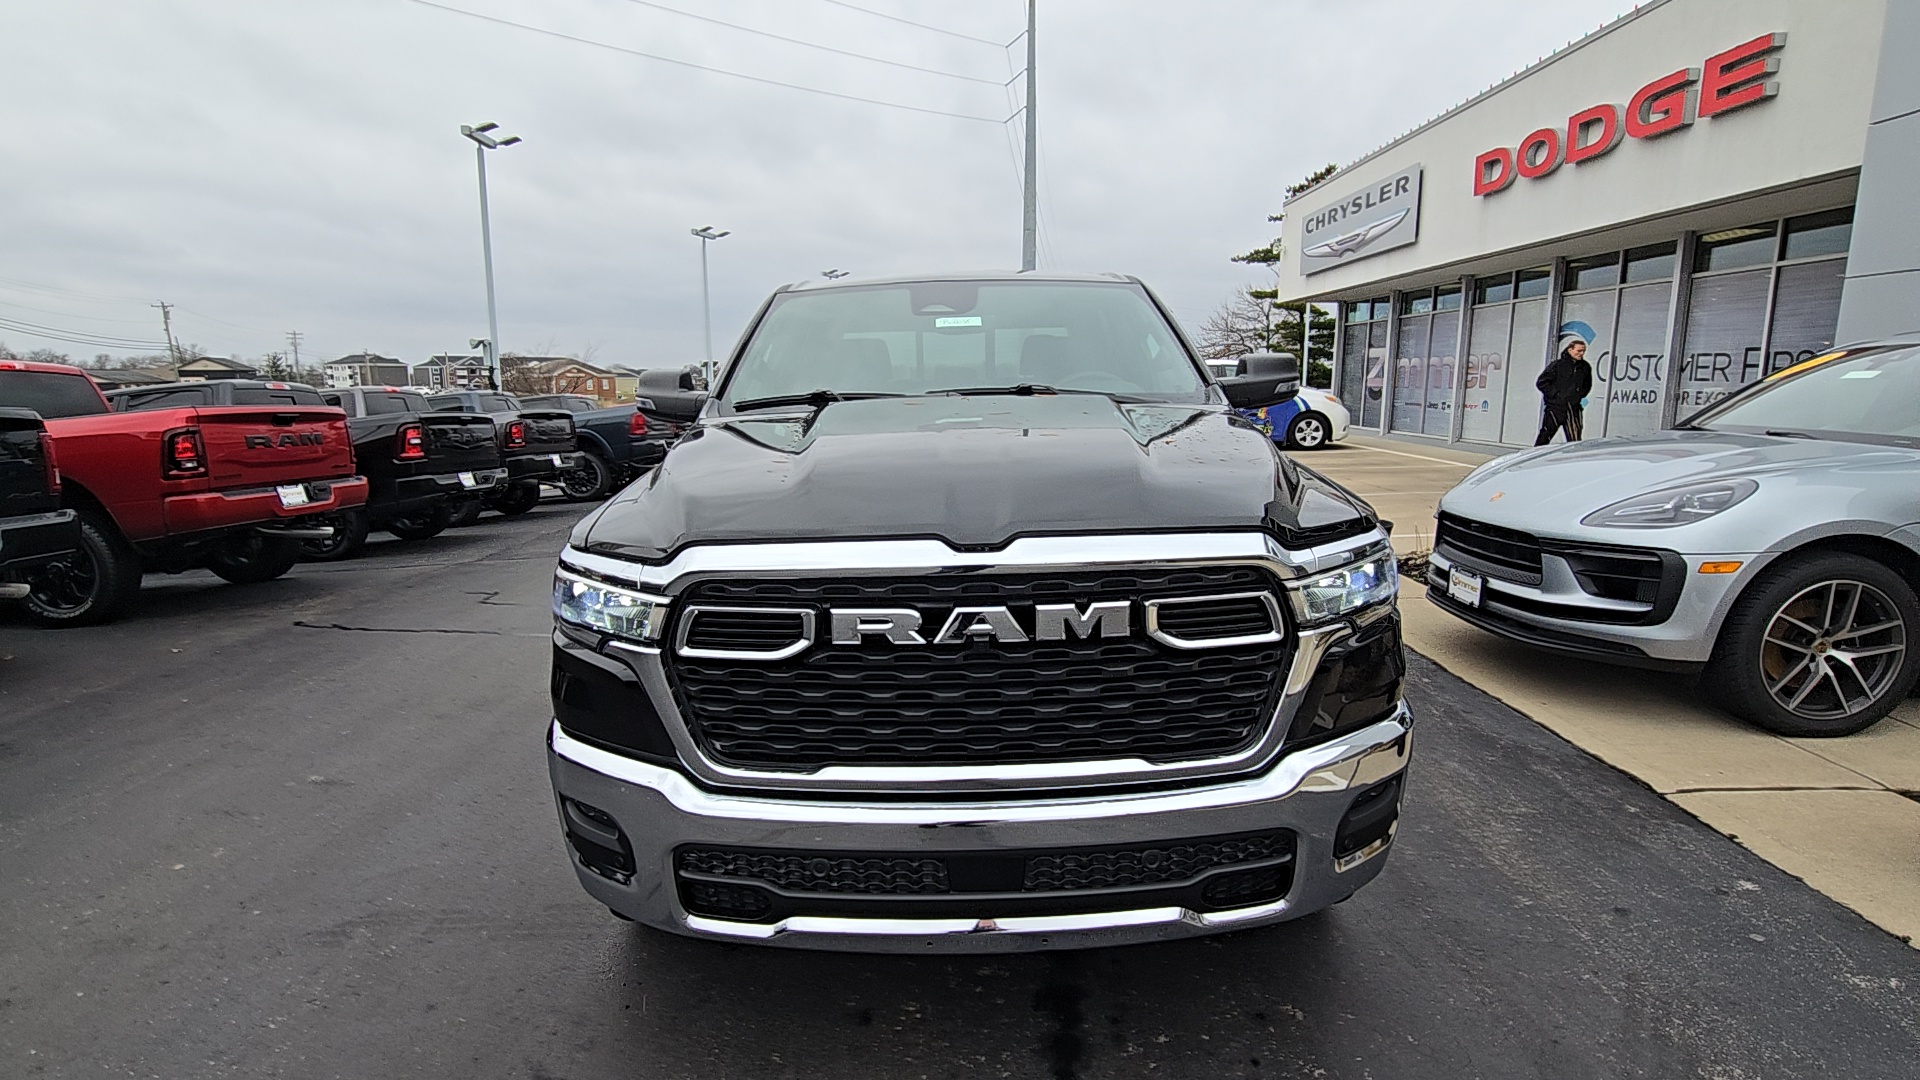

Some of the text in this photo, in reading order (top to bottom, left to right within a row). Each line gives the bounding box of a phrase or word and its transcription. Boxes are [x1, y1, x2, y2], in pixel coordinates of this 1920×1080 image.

[1473, 32, 1786, 196] DODGE
[1305, 175, 1410, 234] CHRYSLER
[1366, 347, 1502, 389] Zmmer
[1611, 390, 1658, 404] AWARD
[244, 431, 324, 449] RAM
[829, 600, 1131, 645] RAM
